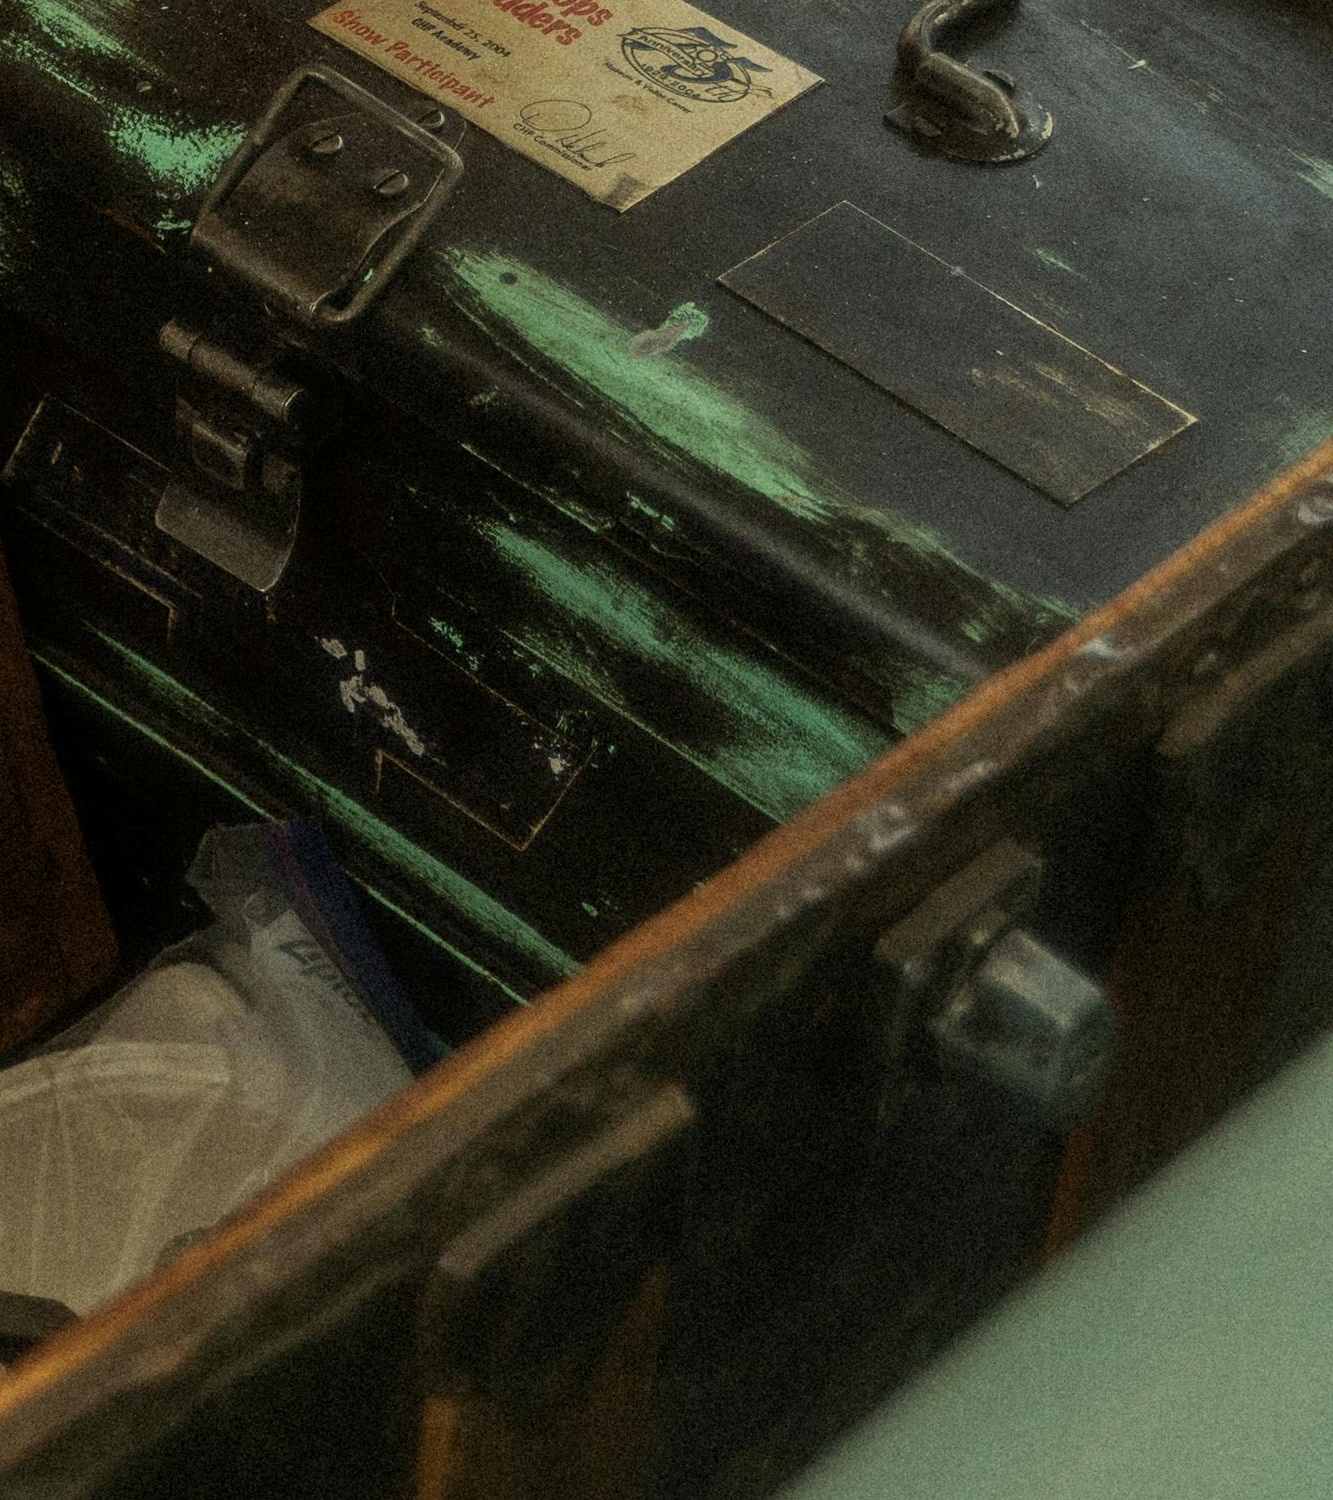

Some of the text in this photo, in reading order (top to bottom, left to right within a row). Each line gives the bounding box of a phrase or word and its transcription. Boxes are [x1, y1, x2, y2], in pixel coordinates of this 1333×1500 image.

[333, 10, 496, 109] Show Participant
[433, 29, 481, 62] Academy
[638, 34, 709, 78] Anniversary
